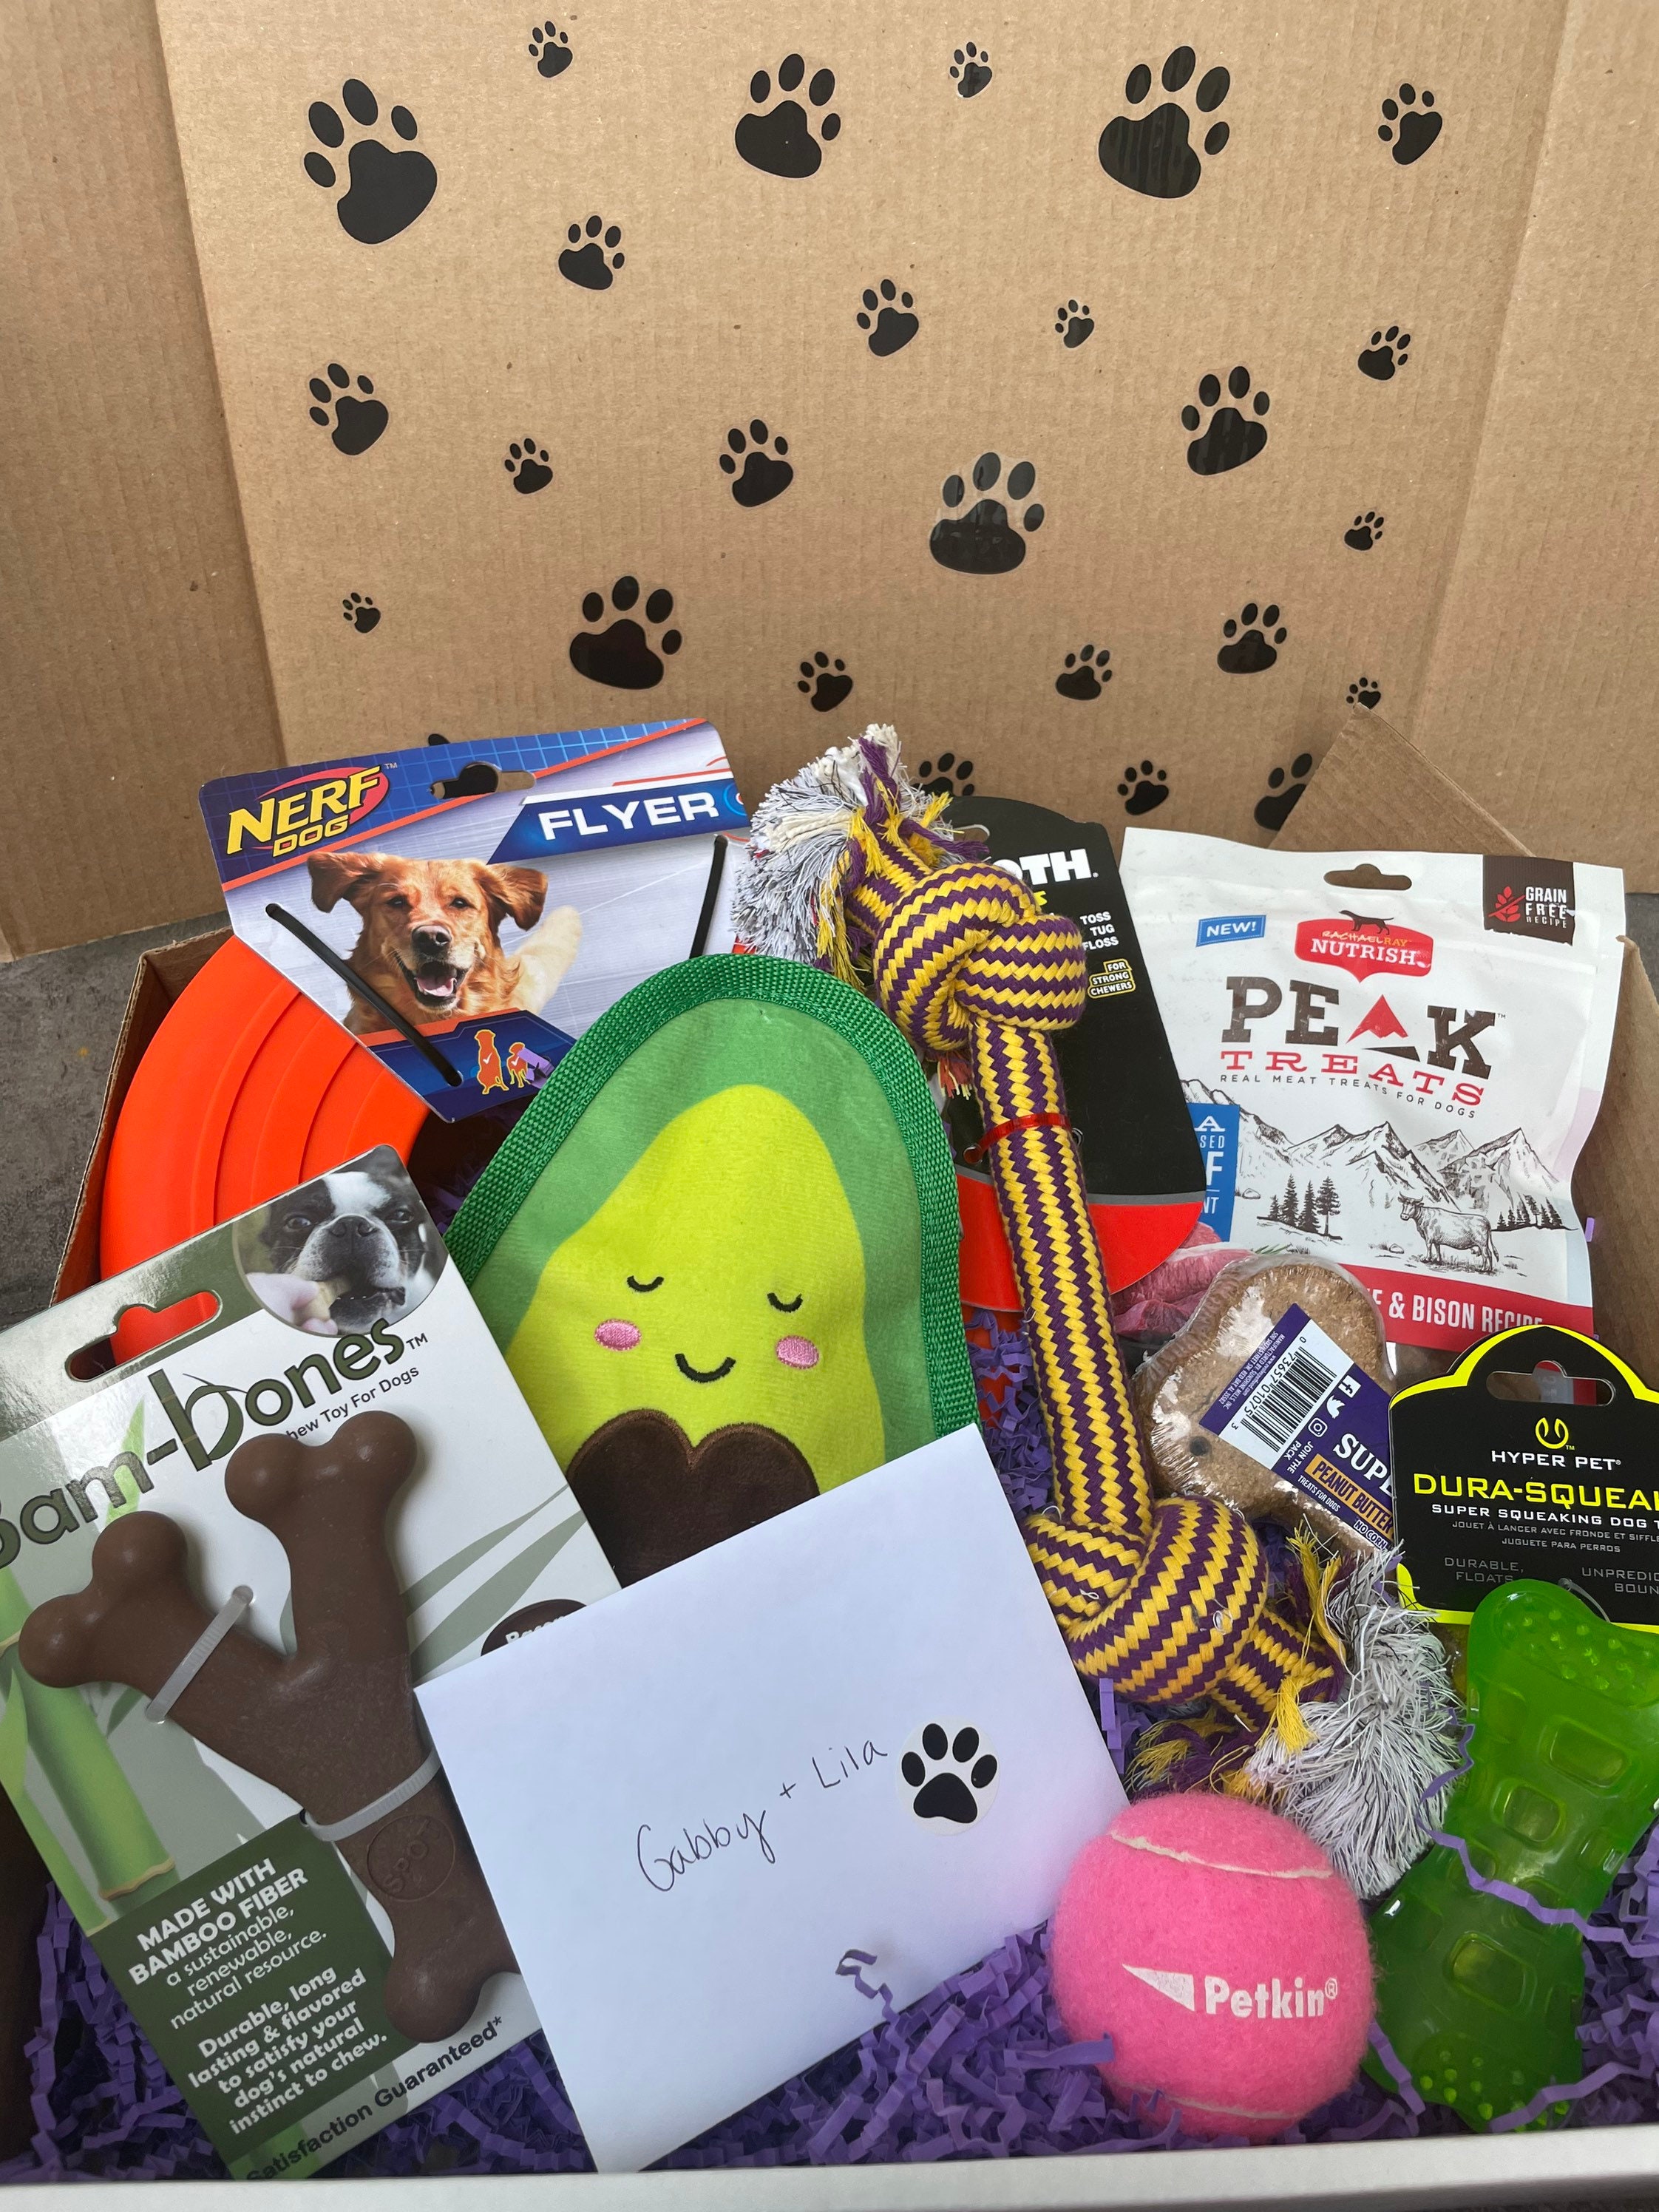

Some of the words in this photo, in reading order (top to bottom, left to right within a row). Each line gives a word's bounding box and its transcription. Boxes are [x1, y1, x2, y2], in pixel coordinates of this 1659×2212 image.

[227, 764, 382, 856] NERF
[537, 792, 719, 841] FLYER
[271, 813, 350, 858] DOG
[1525, 886, 1567, 903] GRAIN
[1079, 912, 1112, 925] TOSS
[1525, 903, 1567, 920] FREE
[1526, 916, 1567, 929] RECIPE
[1082, 936, 1119, 951] FLOSS
[1090, 924, 1115, 937] TUG
[1206, 920, 1258, 937] NEW!
[1107, 961, 1126, 972] FOR
[1311, 938, 1417, 966] NUTRISH
[1090, 981, 1132, 996] CHEWERS
[1092, 971, 1129, 985] STRONG
[1221, 977, 1496, 1079] PEAK
[1221, 1051, 1485, 1106] TREATS
[1272, 1076, 1317, 1085] MEAT
[1329, 1077, 1388, 1095] TREATS
[1397, 1091, 1425, 1106] FOR
[1435, 1101, 1476, 1119] DOGS
[1388, 1292, 1405, 1320] &
[1412, 1295, 1475, 1330] BISON
[1270, 1352, 1296, 1384] 73657
[286, 1419, 319, 1440] hew
[320, 1403, 349, 1423] Toy
[351, 1388, 376, 1408] For
[379, 1366, 420, 1393] Dogs
[1244, 1384, 1271, 1416] 01075
[1231, 1422, 1238, 1431] 3
[1283, 1440, 1302, 1461] PACK
[1286, 1456, 1301, 1474] THE
[1297, 1441, 1314, 1458] JOIN
[1491, 1451, 1565, 1468] HYPER
[1297, 1475, 1317, 1494] TREATS
[1314, 1490, 1328, 1502] FOR
[1326, 1497, 1341, 1513] DOGS
[1312, 1461, 1357, 1502] PEANUT
[1351, 1492, 1394, 1534] BUTTER
[1354, 1520, 1367, 1535] NO
[1431, 1504, 1490, 1517] SUPER
[1498, 1509, 1602, 1525] SQUEAKING
[1610, 1517, 1647, 1528] DOG
[1452, 1521, 1485, 1530] JOUET
[1498, 1524, 1537, 1533] LANCER
[1540, 1527, 1566, 1536] AVEC
[1570, 1530, 1611, 1539] FRONDE
[1502, 1538, 1547, 1547] JUGUETE
[1551, 1541, 1577, 1550] PARA
[1580, 1544, 1621, 1553] PERROS
[1445, 1557, 1524, 1573] DURABLE,
[1456, 1572, 1513, 1583] FLOATS
[637, 1810, 776, 1892] Gabby
[812, 1740, 888, 1789] Lila
[137, 1896, 211, 1952] MADE
[211, 1857, 276, 1907] WITH
[128, 1911, 237, 1986] BAMBOO
[238, 1866, 309, 1922] FIBER
[166, 1971, 182, 1987] a
[186, 1904, 295, 1978] sustainable,
[186, 1930, 294, 1997] renewable,
[170, 1978, 243, 2030] natural
[245, 1930, 328, 1989] resource.
[189, 2040, 261, 2088] lasting
[264, 2025, 281, 2043] &
[281, 1967, 367, 2030] flavored
[197, 1996, 290, 2058] Durable,
[289, 1966, 337, 2002] long
[218, 2076, 241, 2094] to
[245, 2031, 309, 2080] satisfy
[312, 1999, 358, 2039] your
[290, 2018, 365, 2074] natural
[229, 2081, 305, 2135] instinct
[305, 2068, 328, 2088] to
[330, 2033, 387, 2072] chew.
[245, 2103, 373, 2179] Satisfaction
